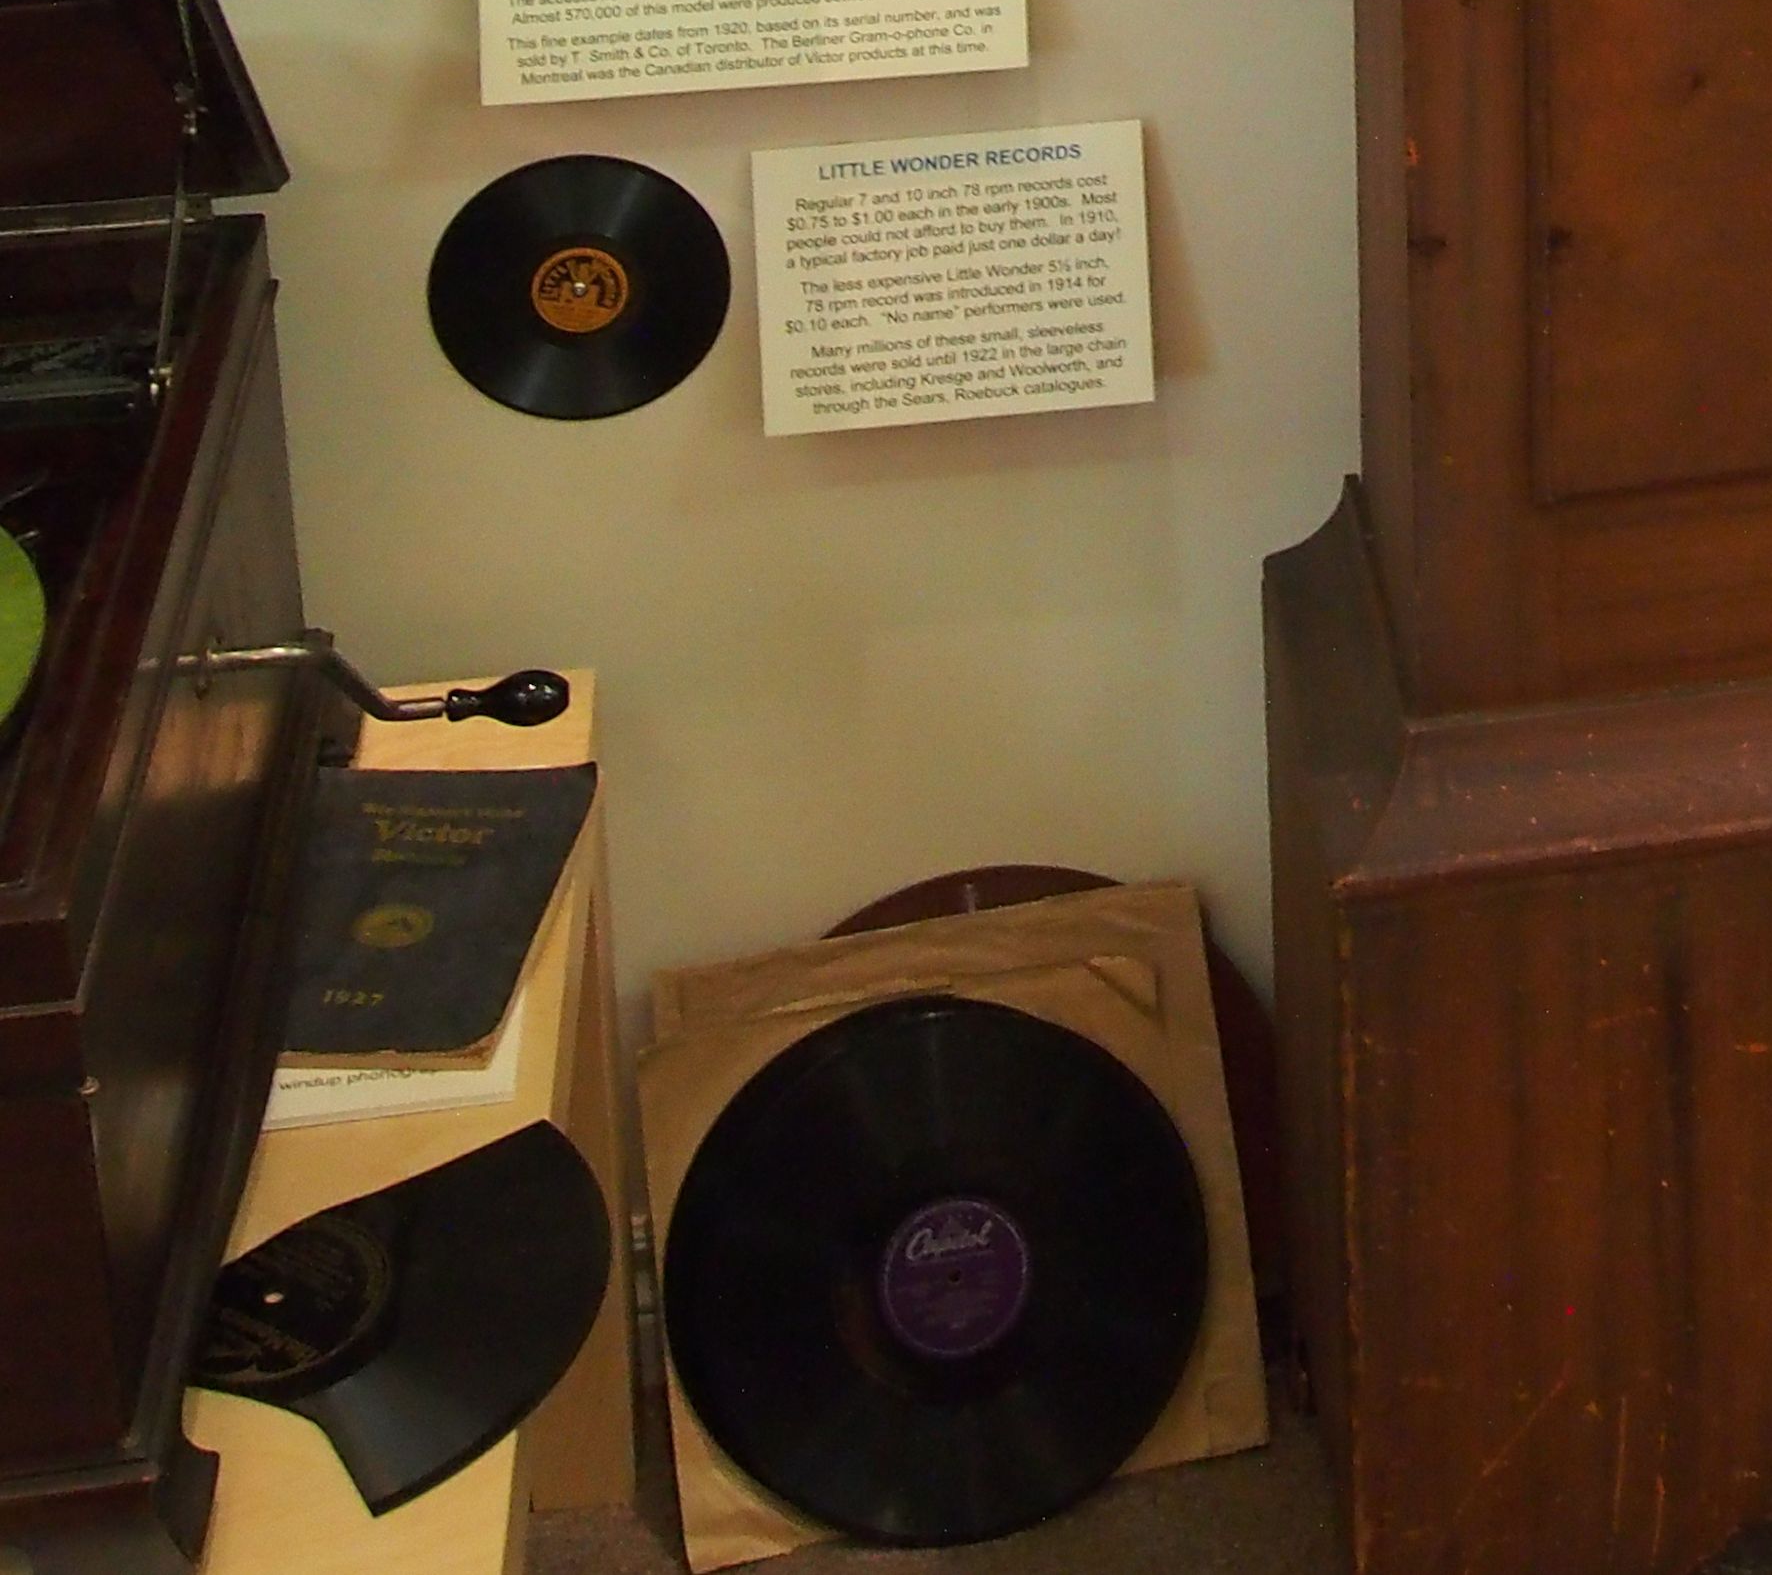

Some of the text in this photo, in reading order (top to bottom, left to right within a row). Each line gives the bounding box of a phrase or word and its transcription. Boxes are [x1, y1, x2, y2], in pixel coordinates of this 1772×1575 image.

[819, 144, 1082, 179] LITTLE WONDER RECORDS
[795, 174, 1108, 212] Regular 7 and 10 inch 78 rpm records cost
[323, 989, 385, 1007] 1927
[906, 1220, 992, 1261] Capitol
